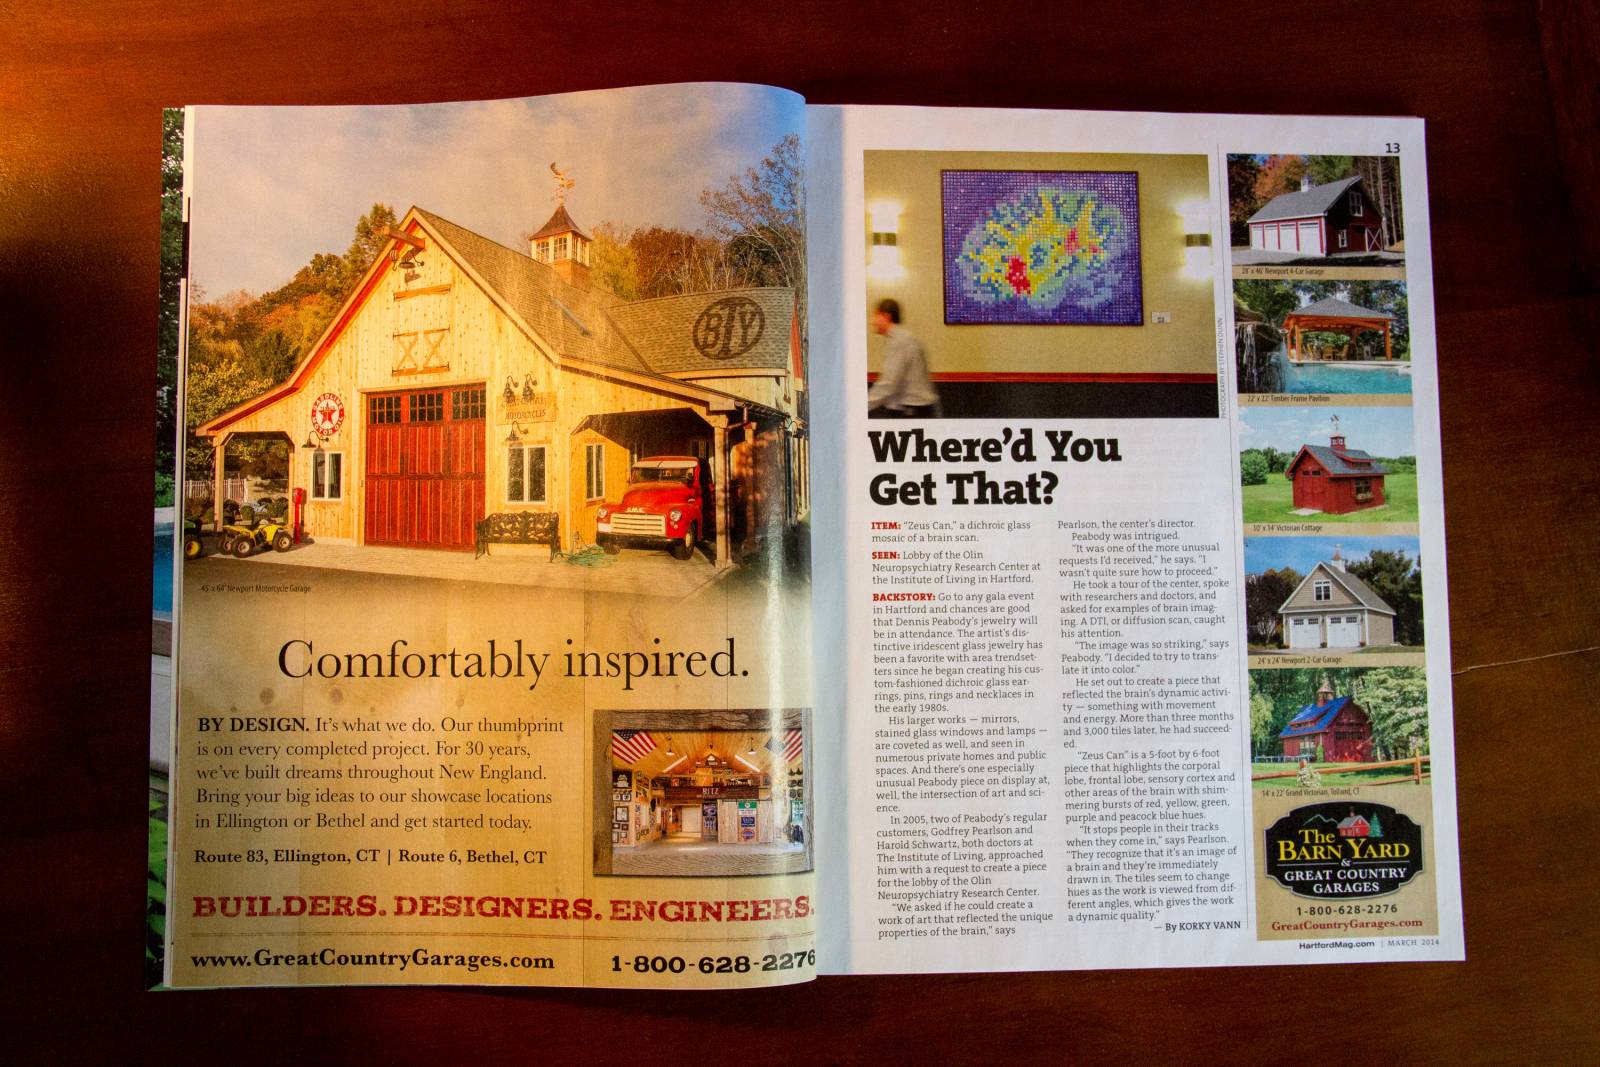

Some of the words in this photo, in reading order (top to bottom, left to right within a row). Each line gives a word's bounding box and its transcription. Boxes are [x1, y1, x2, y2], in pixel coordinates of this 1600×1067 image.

[1385, 142, 1400, 153] 13
[867, 427, 1036, 462] Where'd
[1045, 430, 1122, 462] You
[869, 472, 936, 505] Get
[946, 470, 1058, 505] That?
[871, 521, 901, 530] ITEM:
[967, 520, 1005, 529] dichroic
[1007, 520, 1030, 532] glass
[1057, 519, 1100, 529] Pearlson,
[1101, 519, 1117, 528] the
[1119, 519, 1155, 528] center's
[1157, 518, 1195, 531] director.
[1301, 524, 1322, 532] Cottage
[871, 551, 900, 559] SEEN:
[903, 550, 930, 561] Lobby
[933, 550, 943, 559] of
[945, 550, 960, 559] the
[962, 550, 983, 559] Olin
[872, 560, 952, 574] Neuropsychiatry
[954, 561, 996, 571] Research
[998, 561, 1029, 571] Center
[1031, 562, 1040, 570] at
[872, 592, 935, 601] BACKSTORY:
[938, 592, 951, 600] Go
[965, 594, 983, 603] any
[985, 591, 1005, 602] gala
[1008, 592, 1034, 600] event
[278, 638, 550, 690] Comfortably
[563, 637, 747, 689] inspired.
[1282, 656, 1306, 665] Newport
[1323, 656, 1342, 664] Garage
[197, 717, 224, 731] BY
[230, 716, 309, 732] DESIGN.
[316, 717, 338, 731] It's
[342, 717, 381, 731] what
[385, 721, 406, 731] we
[412, 716, 435, 732] do.
[440, 716, 473, 731] Our
[478, 716, 563, 737] thumbprint
[197, 740, 208, 755] is
[213, 745, 233, 755] on
[239, 745, 281, 760] every
[286, 740, 367, 760] completed
[372, 740, 429, 760] project.
[436, 740, 461, 755] For
[465, 740, 484, 755] 30
[488, 739, 530, 760] years,
[196, 764, 239, 779] we've
[245, 764, 280, 779] built
[285, 764, 342, 779] dreams
[348, 764, 434, 783] throughout
[439, 764, 474, 779] New
[480, 764, 546, 784] England.
[196, 787, 240, 807] Bring
[244, 792, 281, 807] your
[286, 787, 311, 807] big
[315, 787, 354, 802] ideas
[359, 791, 374, 802] to
[379, 792, 406, 802] our
[410, 787, 481, 802] showcase
[485, 787, 552, 803] locations
[1285, 787, 1303, 796] Grand
[1304, 788, 1329, 797] Victorian,
[1330, 787, 1352, 796] Tolland,
[195, 813, 209, 828] in
[216, 812, 288, 832] Ellington
[293, 817, 311, 827] or
[316, 812, 365, 827] Bethel
[370, 812, 399, 827] and
[404, 816, 427, 832] get
[432, 813, 483, 828] started
[489, 813, 532, 833] today.
[890, 815, 900, 824] In
[903, 815, 928, 825] 2005,
[930, 815, 949, 823] two
[951, 813, 962, 823] of
[963, 812, 1010, 825] Peabody's
[1012, 811, 1047, 824] regular
[1065, 810, 1097, 824] purple
[1098, 811, 1117, 821] and
[1119, 810, 1157, 823] peacock
[1159, 810, 1179, 823] blue
[1181, 809, 1205, 819] hues.
[1298, 829, 1335, 843] The
[1278, 840, 1342, 861] BARN
[1346, 838, 1410, 858] YARD
[194, 849, 242, 862] Route
[246, 849, 268, 864] 83,
[273, 849, 351, 866] Ellington,
[356, 848, 380, 861] CT
[398, 848, 444, 862] Route
[449, 849, 461, 865] 6,
[466, 849, 518, 865] Bethel,
[523, 850, 547, 863] CT
[1284, 870, 1332, 881] GREAT
[1337, 868, 1407, 879] COUNTRY
[1313, 882, 1380, 893] GARAGES
[192, 894, 386, 917] BUILDERS.
[393, 895, 602, 920] DESIGNERS.
[609, 895, 814, 922] ENGINEERS.
[1296, 904, 1398, 916] 1-800-628-2276
[1165, 922, 1177, 933] By
[1179, 921, 1211, 930] KORKY
[1213, 920, 1241, 929] VANN
[1271, 918, 1422, 932] GreatCountryGarages.com
[1299, 940, 1375, 949] HartfordMag.com
[191, 949, 555, 972] www.GreatCountryGarages.com
[611, 948, 817, 974] 1-800-628-2276
